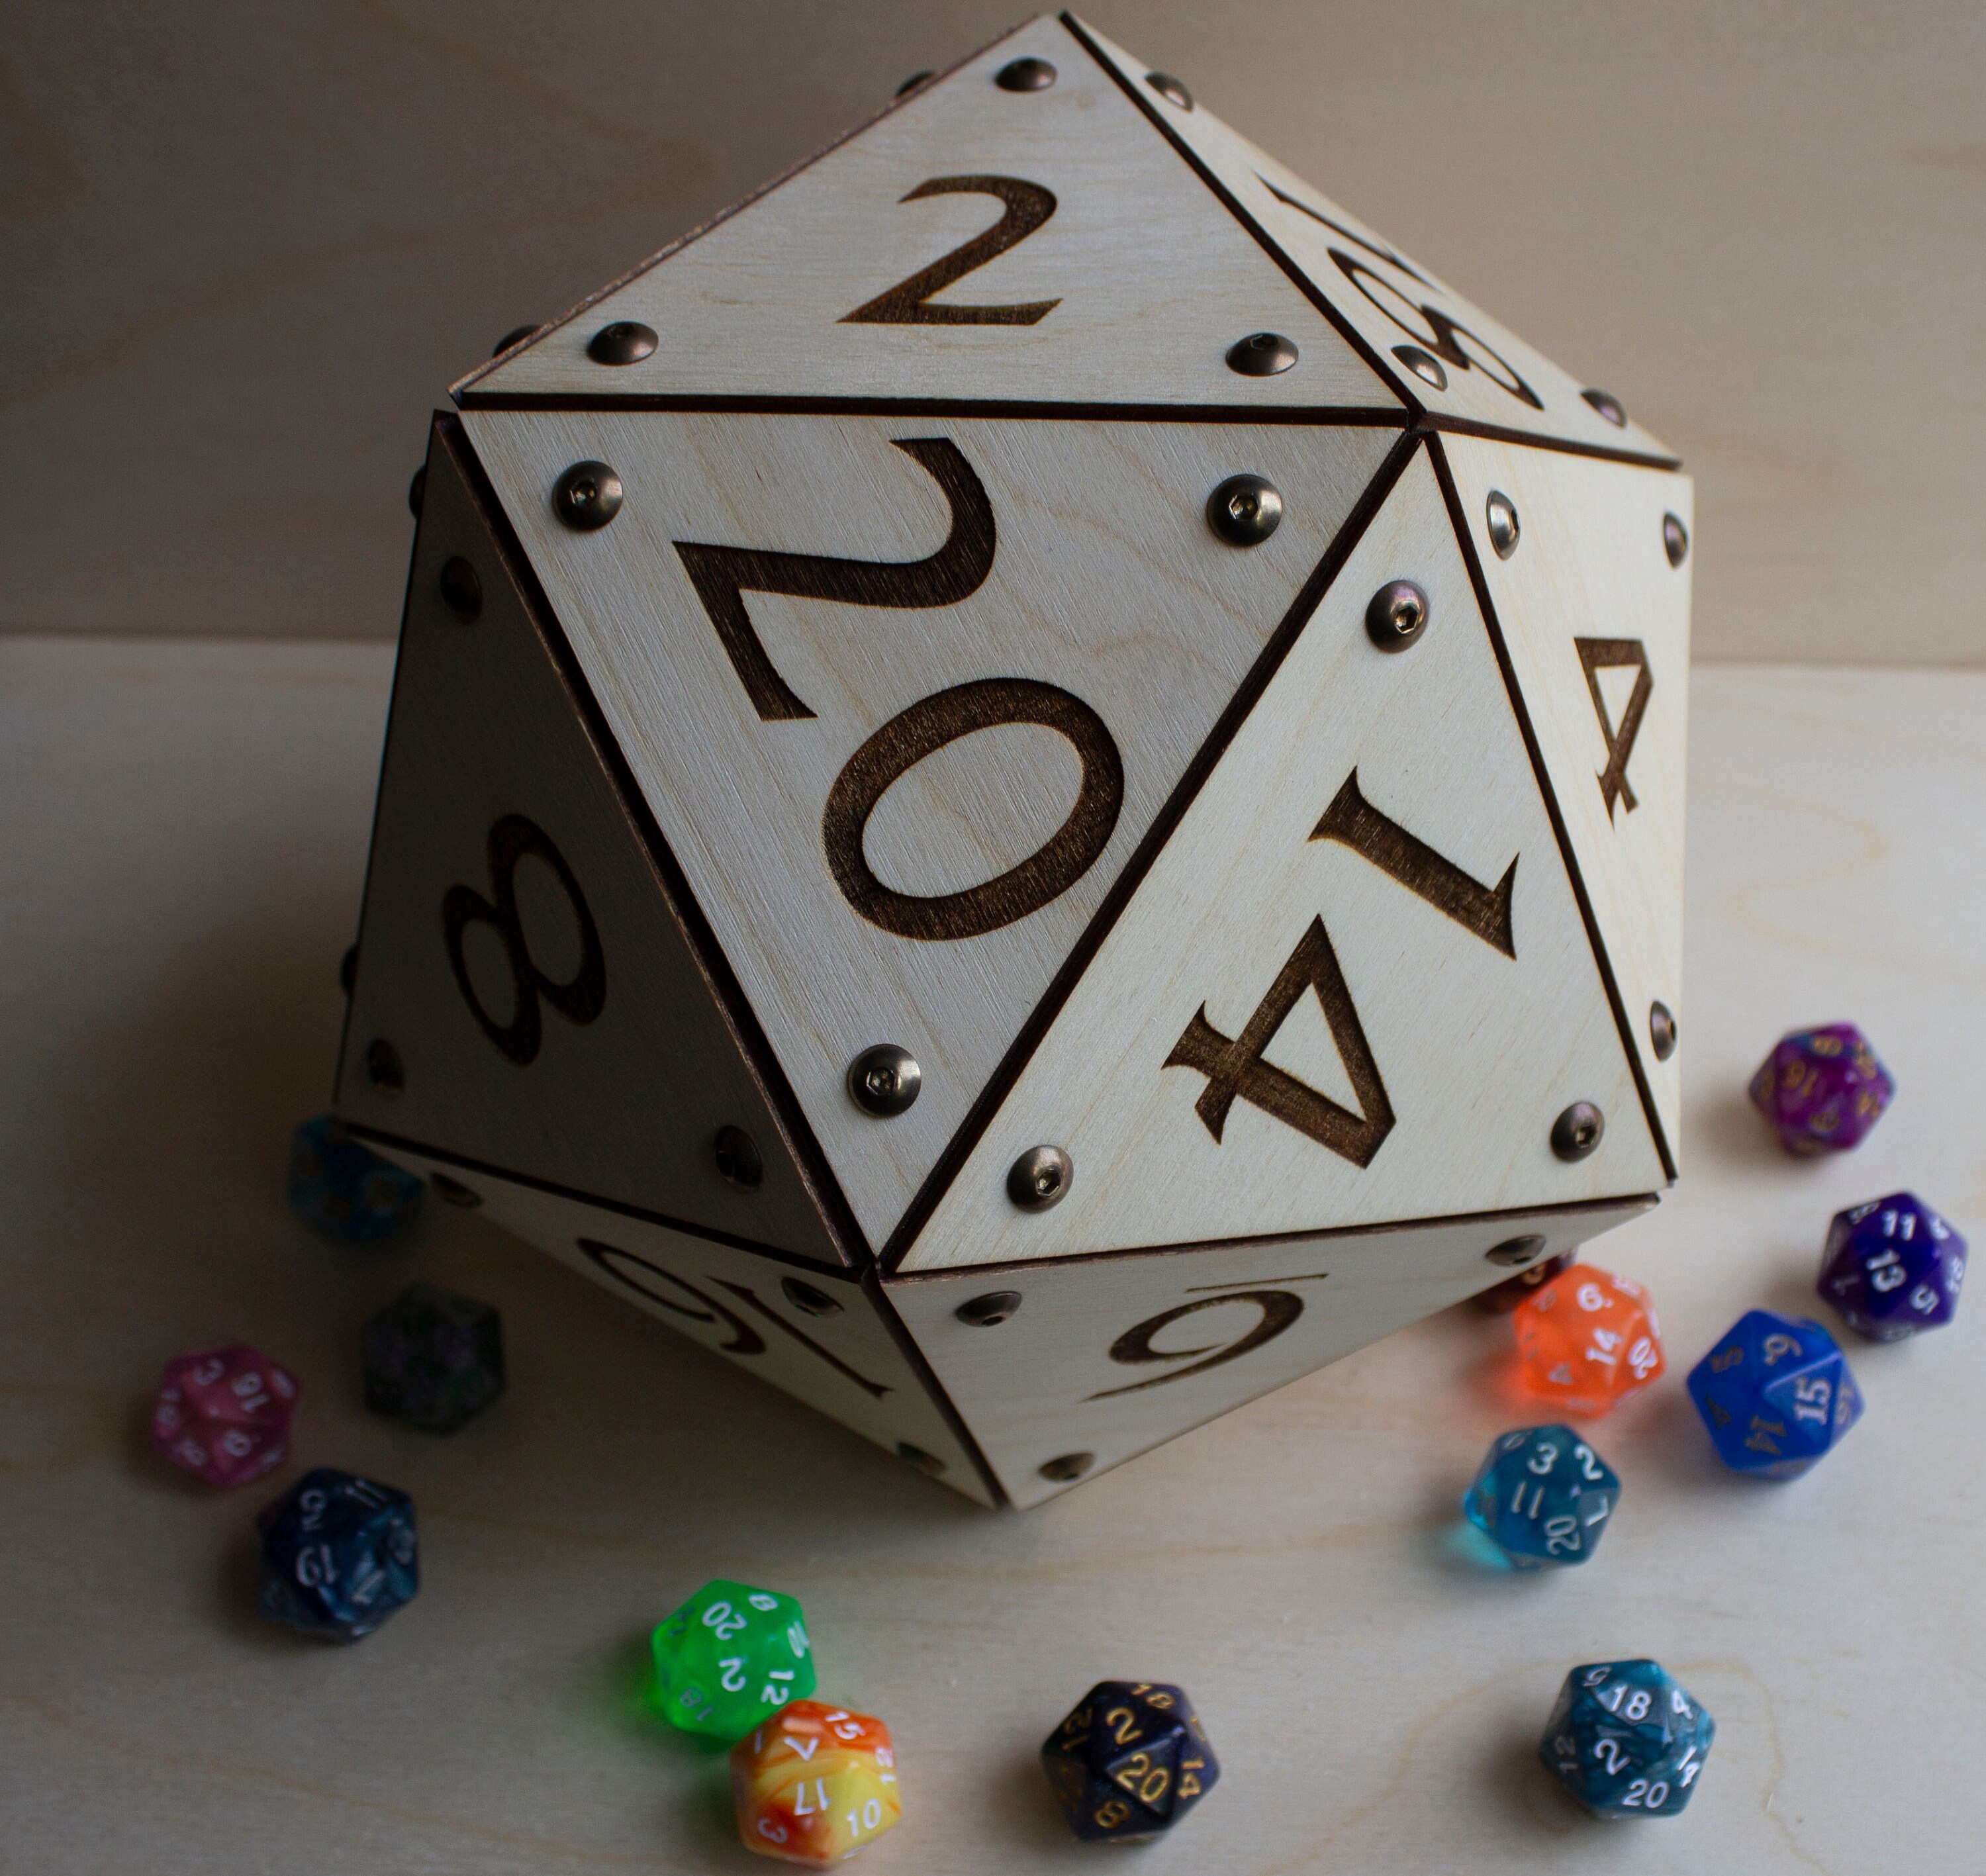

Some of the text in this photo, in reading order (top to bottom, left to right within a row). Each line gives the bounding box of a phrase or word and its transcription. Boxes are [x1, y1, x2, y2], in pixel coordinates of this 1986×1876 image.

[836, 174, 1064, 326] 2
[1253, 170, 1545, 411] 18
[672, 437, 1124, 941] 20
[1574, 636, 1654, 832] 4
[442, 813, 607, 1067] 8
[1160, 764, 1521, 1170] 14
[1881, 1209, 1916, 1241] 11
[1866, 1248, 1907, 1292] 13
[576, 1237, 896, 1402] 16
[1585, 1327, 1625, 1366] 14
[1627, 1337, 1658, 1380] 20
[1793, 1376, 1832, 1426] 15
[1527, 1442, 1559, 1475] 3
[1574, 1444, 1604, 1481] 2
[1510, 1479, 1545, 1521] 11
[1544, 1515, 1582, 1556] 20
[702, 1600, 747, 1641] 20
[718, 1657, 746, 1692] 2
[761, 1669, 795, 1705] 12
[1609, 1683, 1652, 1721] 18
[1671, 1689, 1693, 1720] 4
[1106, 1707, 1143, 1746] 2
[784, 1736, 820, 1761] 7
[1593, 1738, 1632, 1777] 2
[794, 1778, 832, 1816] 17
[1115, 1752, 1170, 1803] 20
[1176, 1758, 1206, 1800] 14
[1621, 1778, 1670, 1809] 20
[757, 1817, 788, 1844] 3
[847, 1798, 881, 1838] 10
[1094, 1800, 1131, 1829] 8
